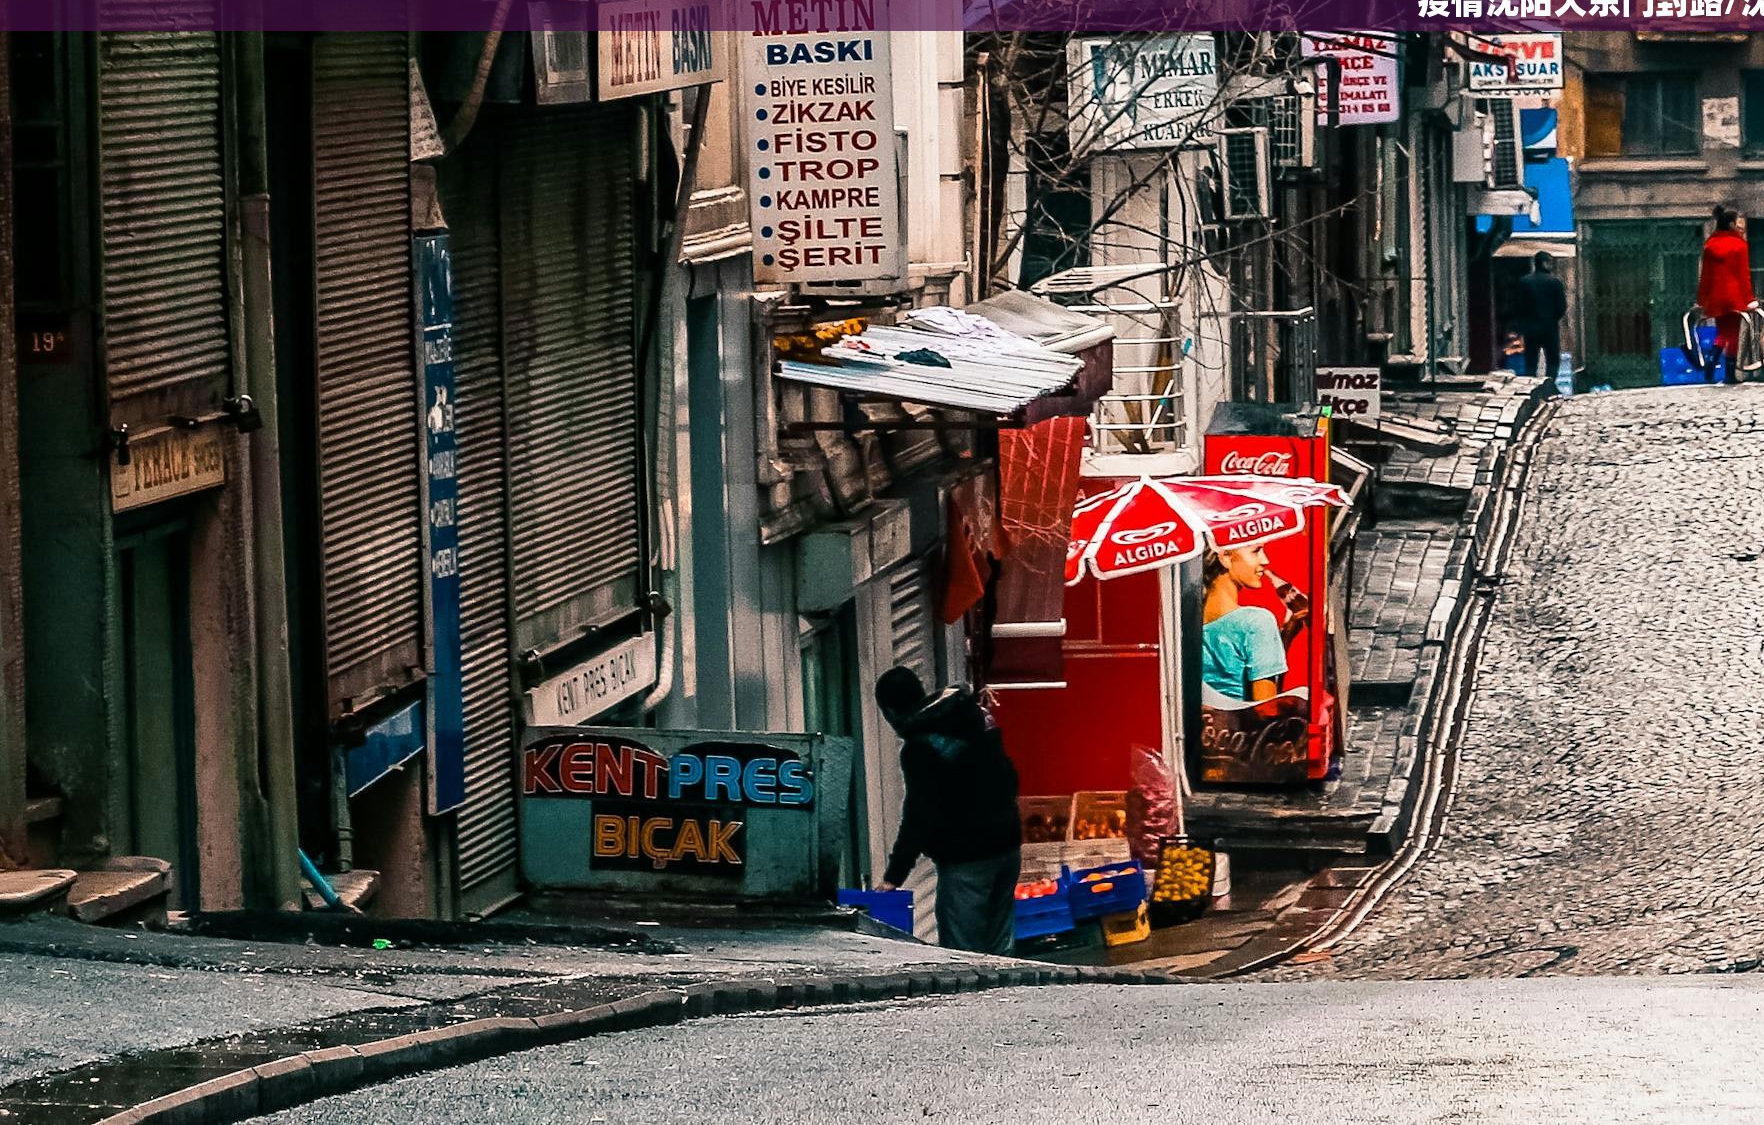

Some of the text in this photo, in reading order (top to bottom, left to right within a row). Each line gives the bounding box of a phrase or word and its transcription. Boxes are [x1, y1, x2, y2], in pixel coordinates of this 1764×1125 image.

[671, 5, 713, 75] BASKI
[766, 39, 873, 66] BASKI
[1472, 62, 1559, 76] AKSSUAR
[770, 72, 876, 98] BİYE KESİLİR
[771, 100, 876, 125] ZİKZAK
[773, 127, 878, 155] FİSTO
[774, 158, 880, 183] TROP
[776, 187, 880, 211] KAMPRE
[777, 214, 883, 245] ŞİLTE
[778, 241, 886, 272] ŞERİT
[594, 813, 744, 870] BIÇAK
